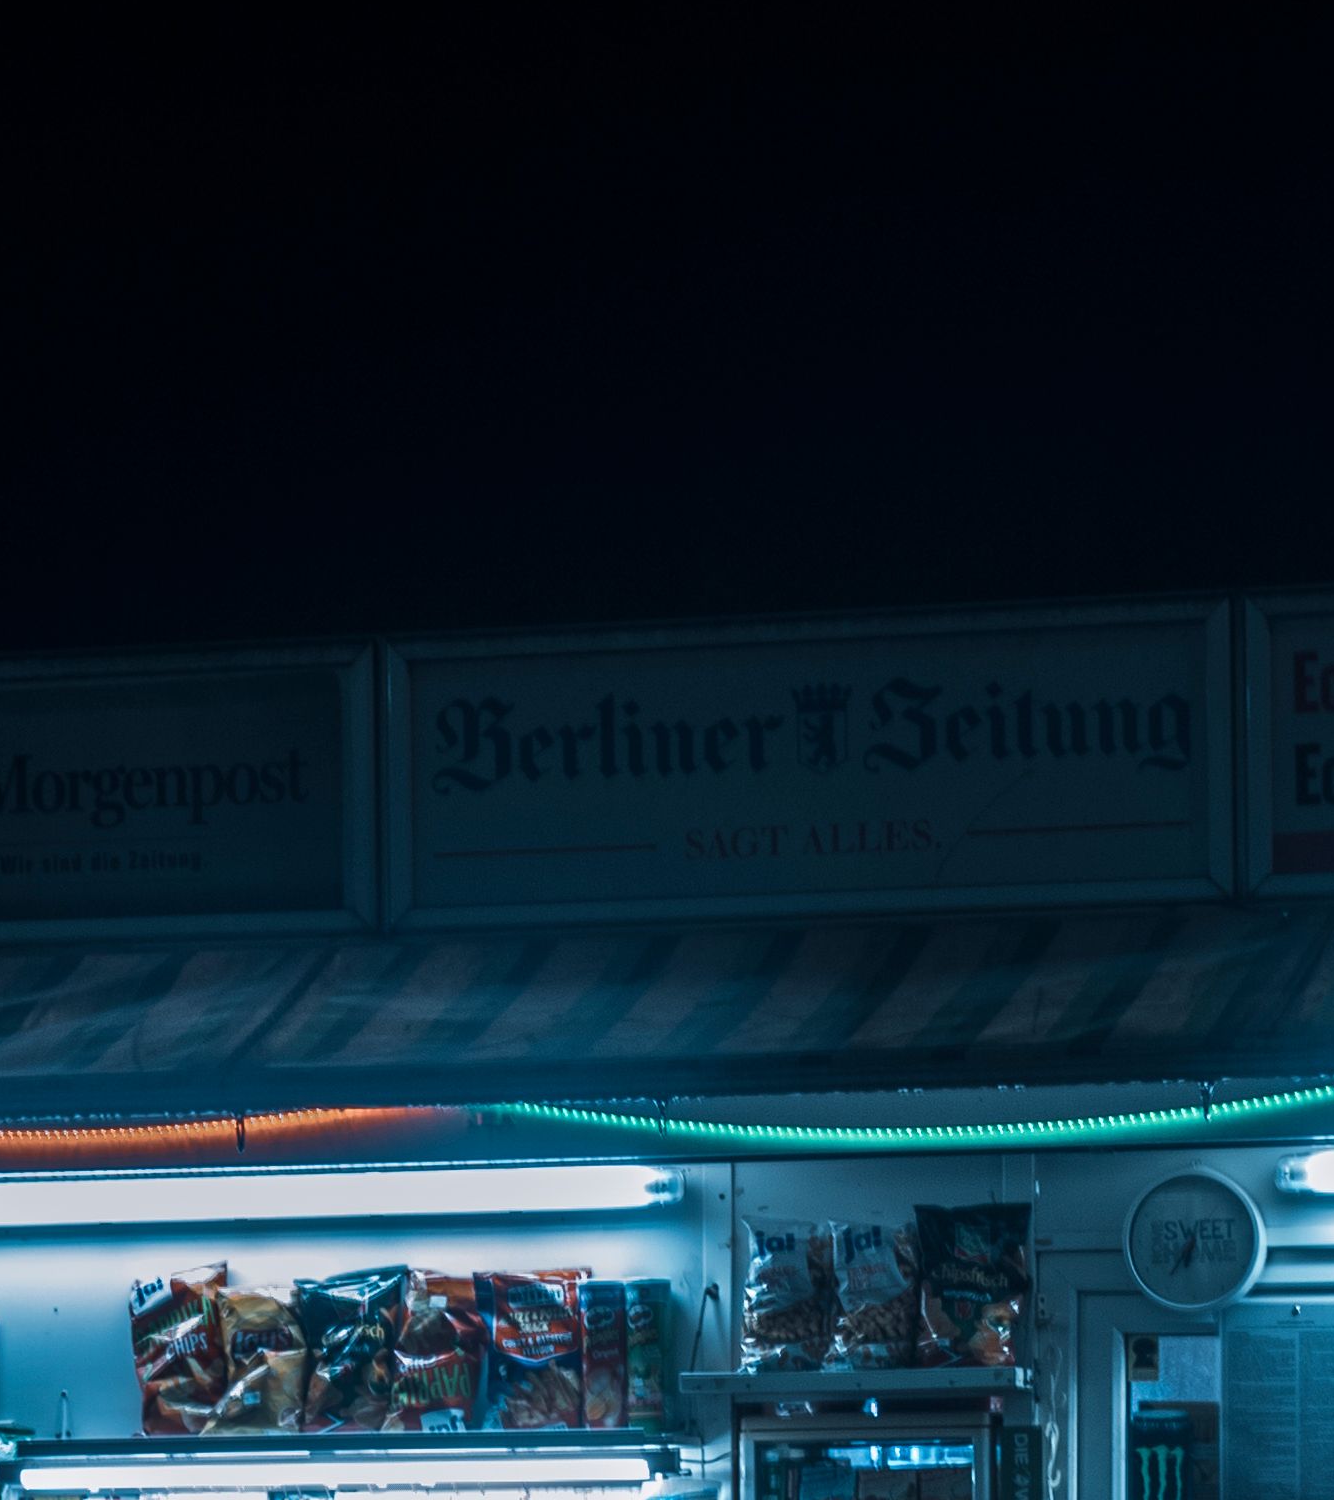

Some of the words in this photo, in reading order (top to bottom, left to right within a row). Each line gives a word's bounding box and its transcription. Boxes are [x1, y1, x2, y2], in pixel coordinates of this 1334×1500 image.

[432, 691, 784, 794] Berliner
[863, 676, 1195, 773] Zeitung
[685, 822, 793, 862] SAGT
[807, 818, 943, 856] ALLES.
[0, 852, 33, 876] Wir
[40, 851, 84, 874] sind
[91, 850, 120, 872] die
[842, 1225, 882, 1265] ja!
[1163, 1219, 1236, 1241] SWEET
[754, 1231, 795, 1263] ja!
[167, 1331, 210, 1359] CHIPS
[1013, 1432, 1031, 1466] DIE
